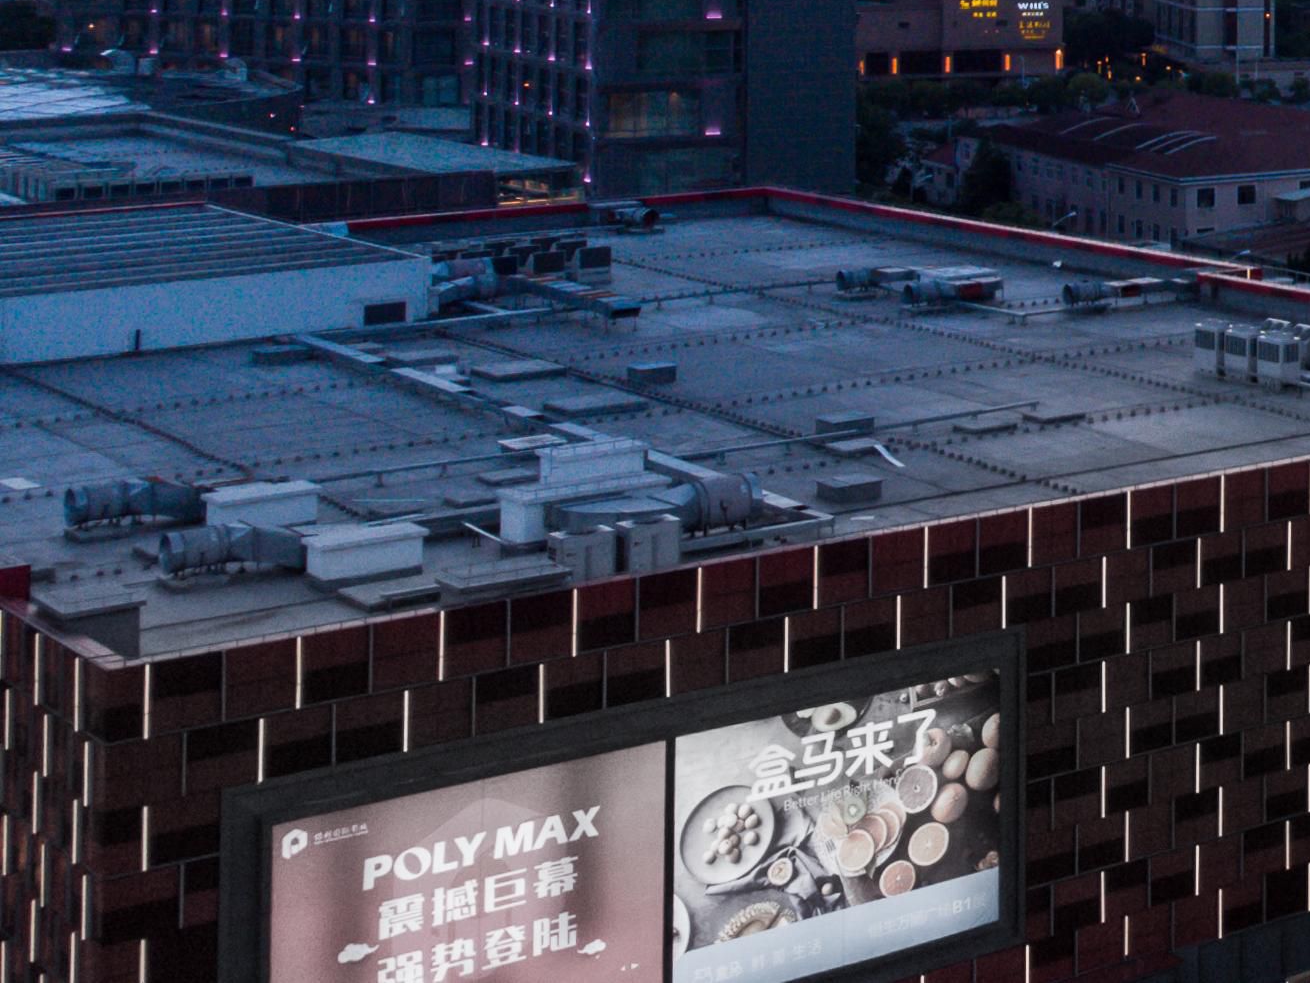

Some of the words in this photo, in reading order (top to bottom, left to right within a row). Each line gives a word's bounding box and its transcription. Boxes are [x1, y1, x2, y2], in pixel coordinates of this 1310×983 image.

[746, 708, 937, 803] 盒马来了
[783, 793, 819, 812] Better
[820, 787, 842, 803] Life
[843, 781, 872, 800] Right
[362, 831, 487, 891] POLY
[493, 805, 601, 859] MAX
[378, 856, 579, 940] 震撼巨幕
[377, 911, 577, 983] 强势登陆
